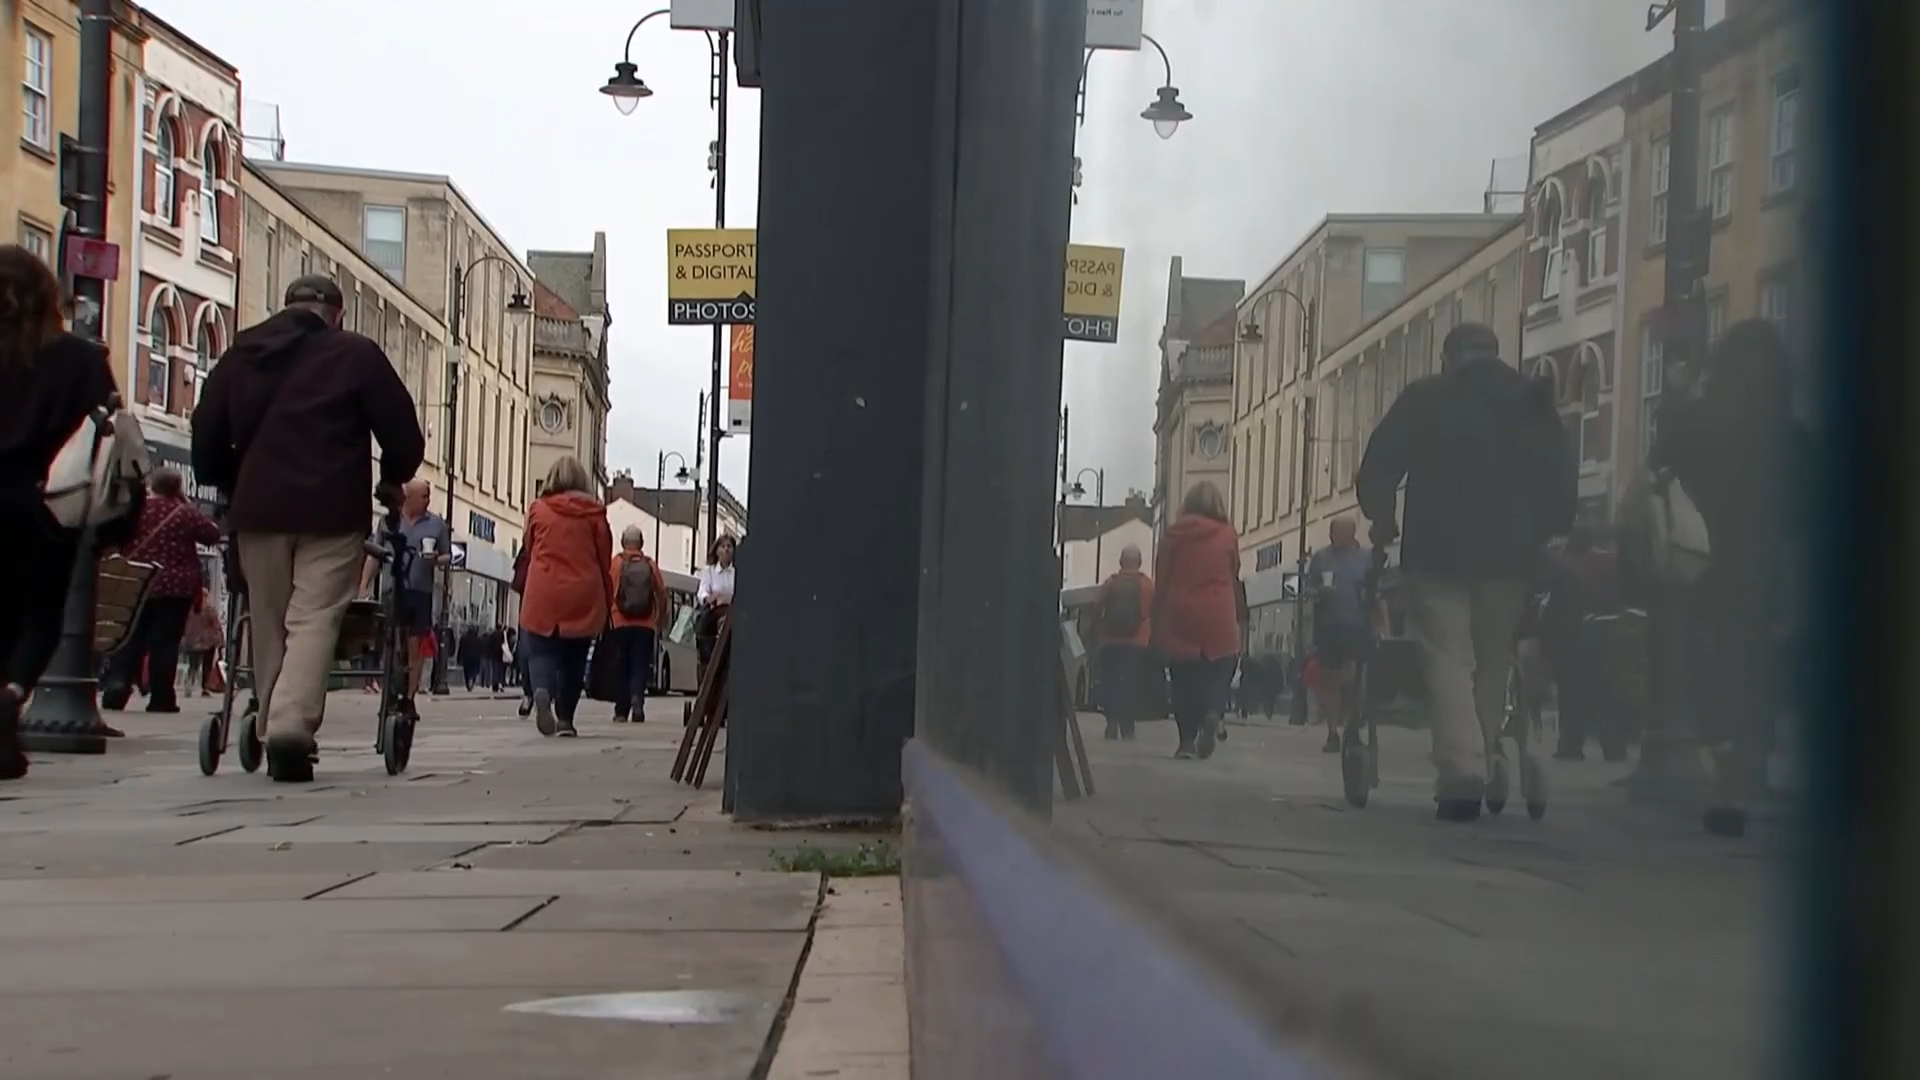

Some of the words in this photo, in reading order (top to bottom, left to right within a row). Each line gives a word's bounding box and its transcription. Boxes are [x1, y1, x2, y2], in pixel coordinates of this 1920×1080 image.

[675, 243, 755, 258] PASSPORT
[675, 265, 687, 280] &
[692, 265, 755, 280] DIGITAL
[674, 302, 756, 320] PHOTOS
